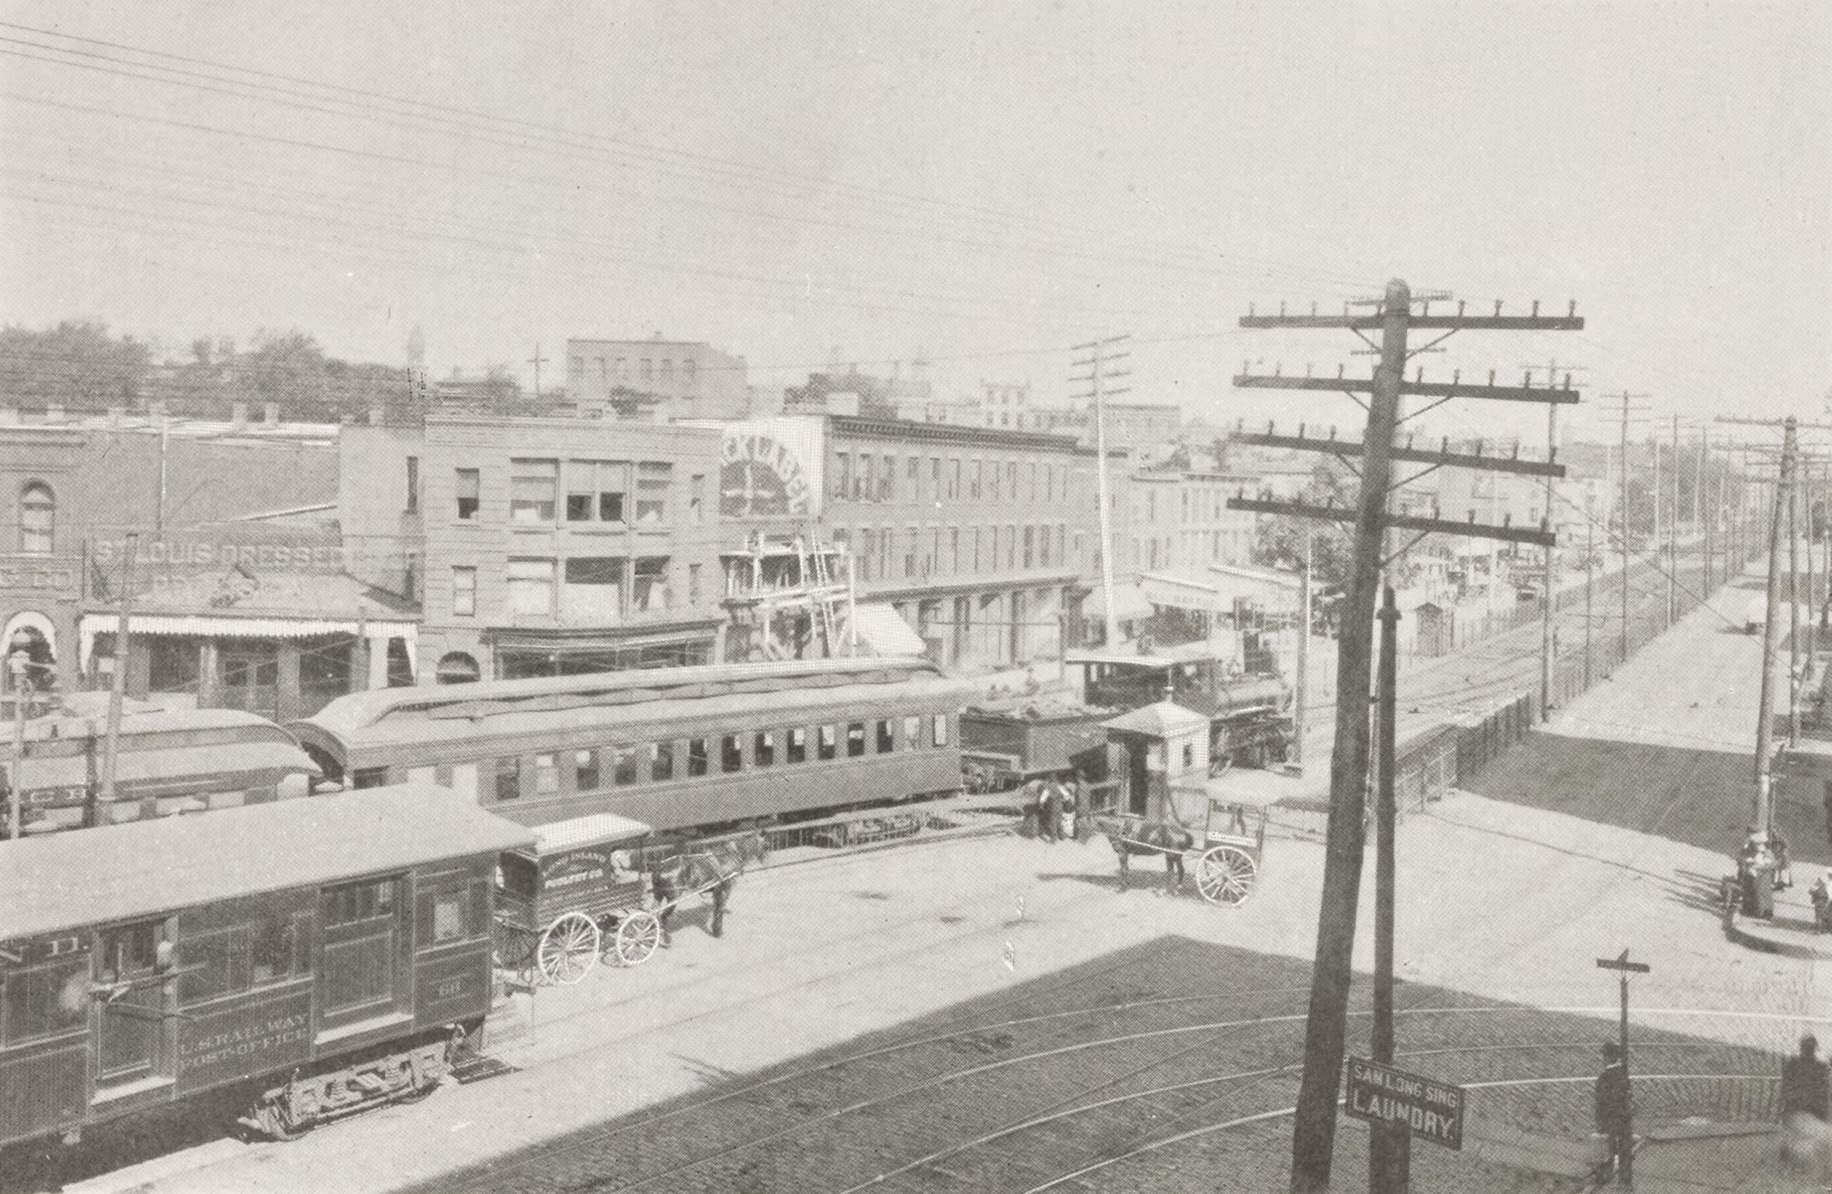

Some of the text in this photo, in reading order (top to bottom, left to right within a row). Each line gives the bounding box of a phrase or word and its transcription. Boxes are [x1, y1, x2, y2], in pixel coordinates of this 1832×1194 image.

[134, 541, 214, 564] LOUIS
[220, 545, 345, 568] DRESSED
[1354, 1064, 1457, 1108] SAM LONG SING
